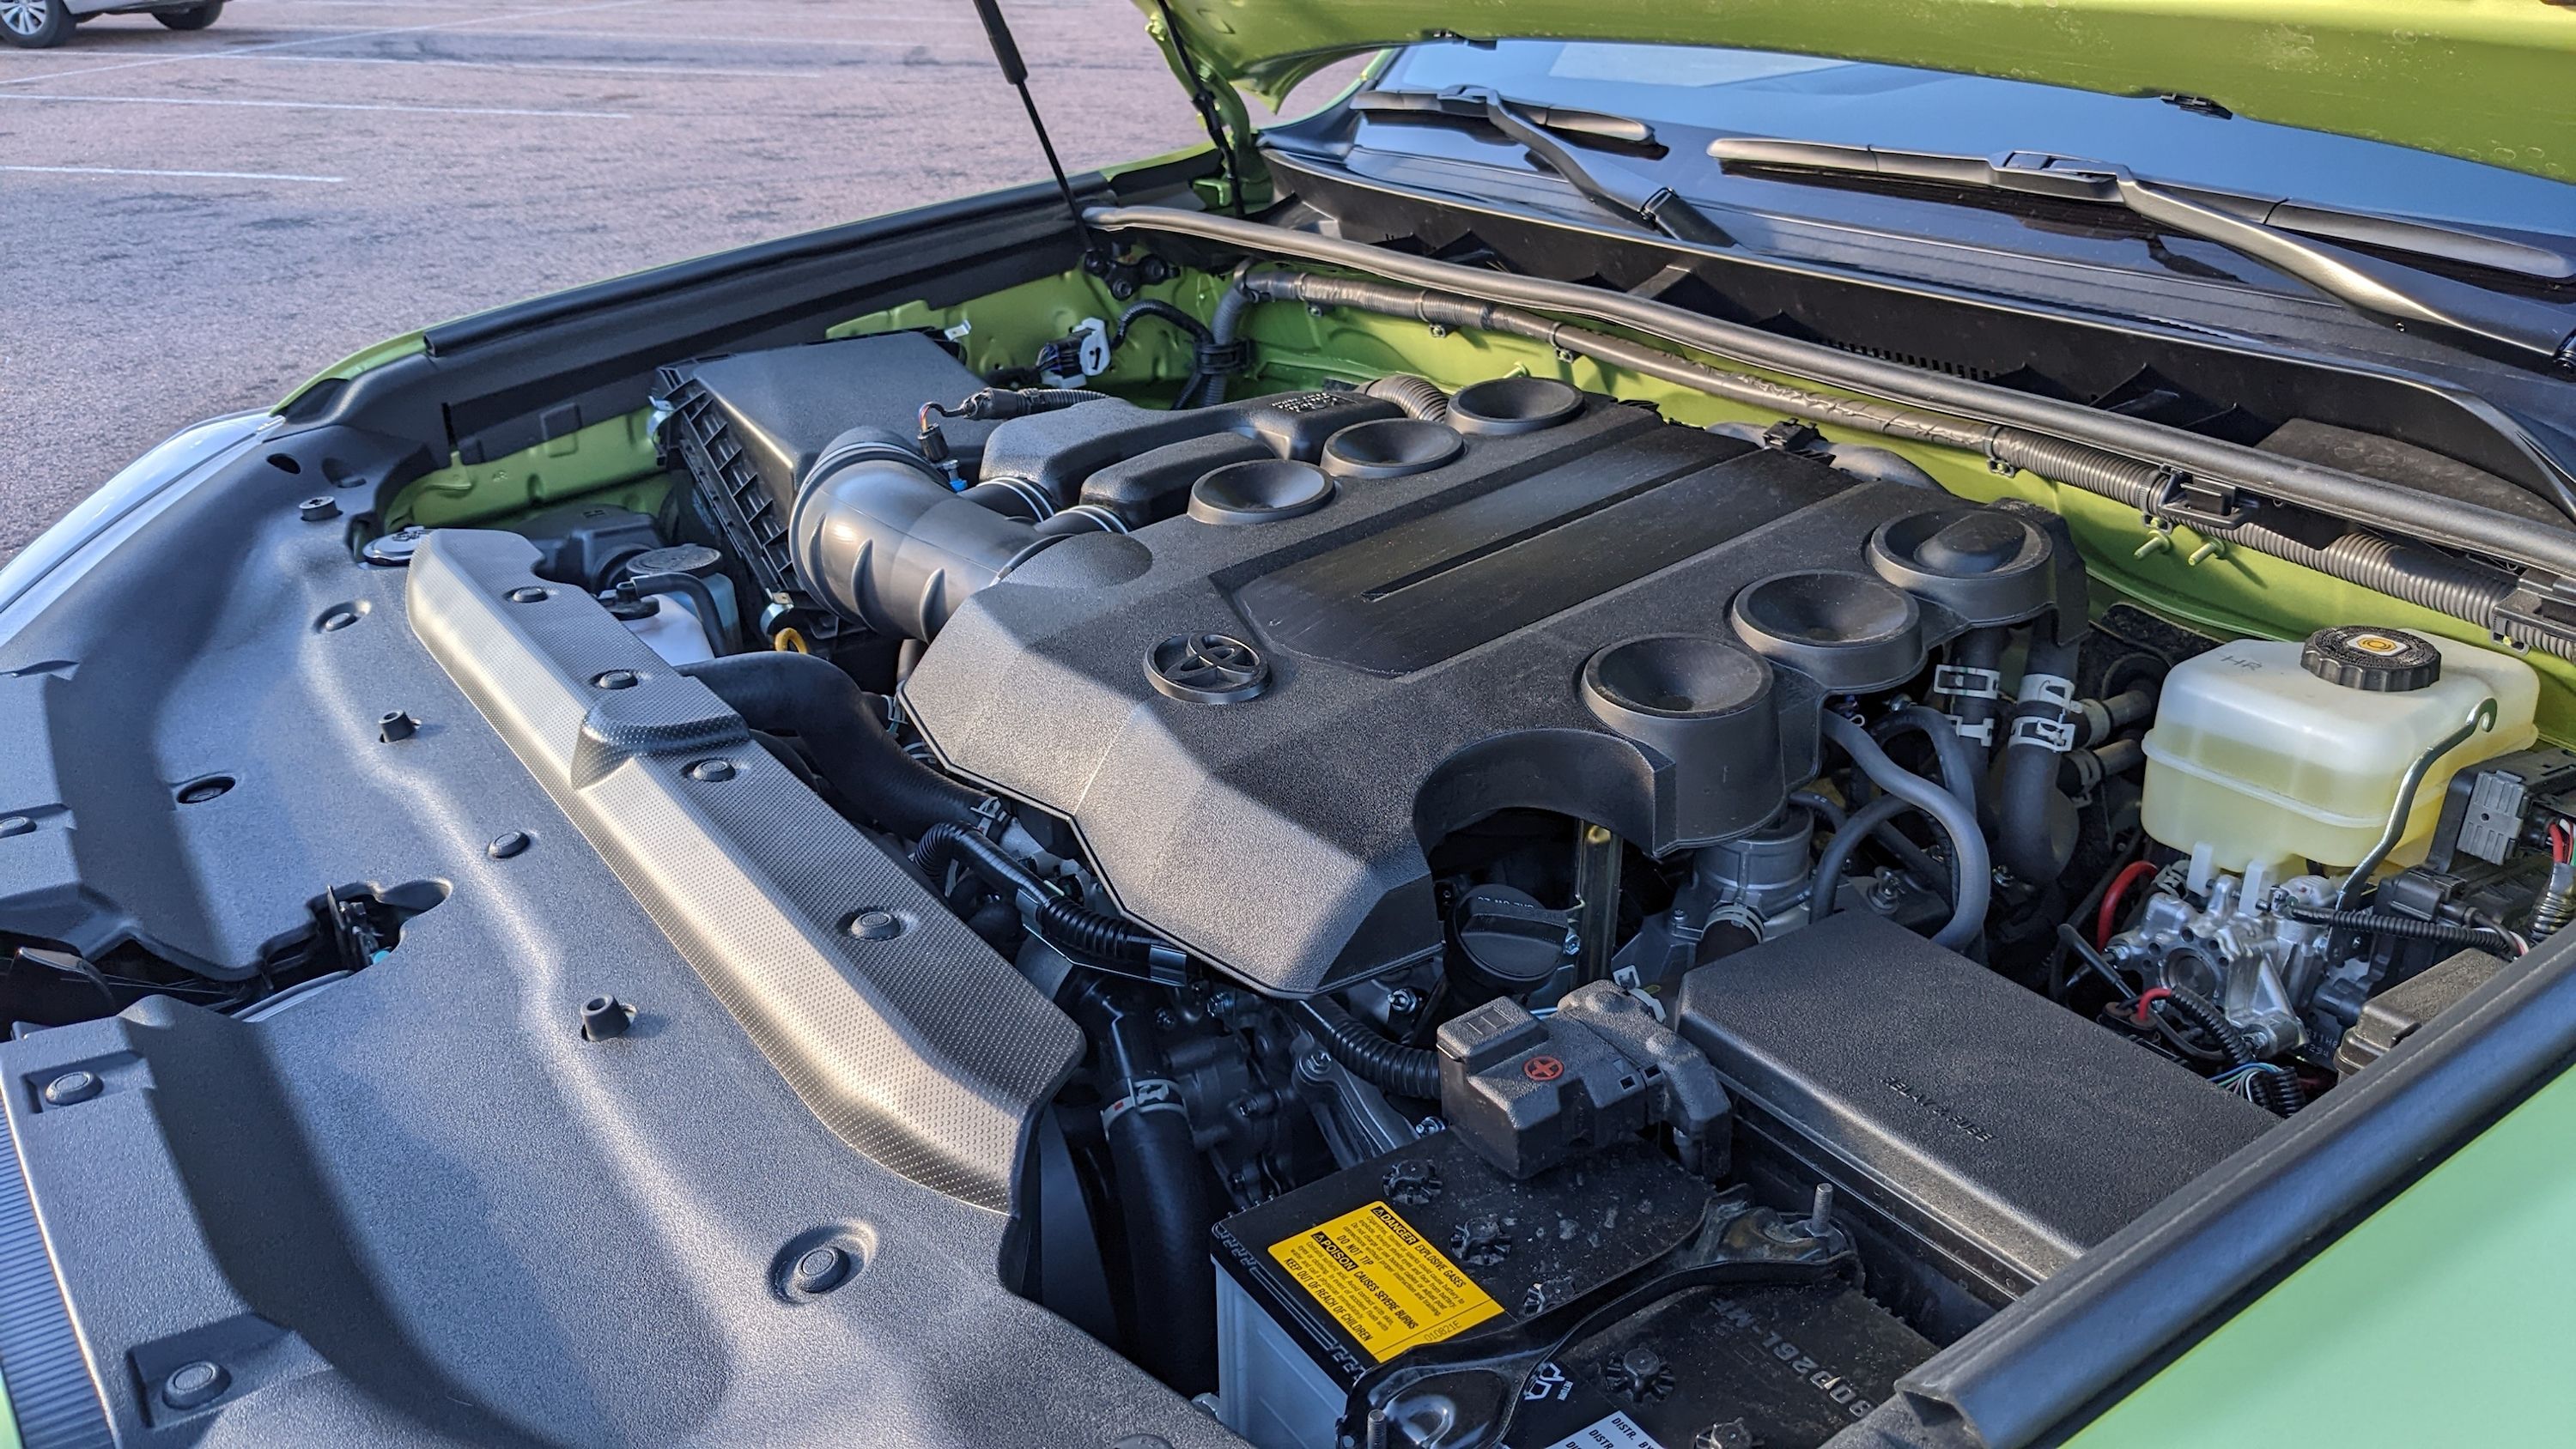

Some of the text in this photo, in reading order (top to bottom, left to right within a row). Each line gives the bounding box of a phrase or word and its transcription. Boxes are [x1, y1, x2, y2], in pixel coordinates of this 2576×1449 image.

[1291, 1249, 1303, 1259] water
[1318, 1277, 1340, 1295] physician
[1306, 1241, 1324, 1258] Contains
[1346, 1280, 1361, 1292] Avoid
[1358, 1291, 1376, 1306] contact
[1373, 1306, 1385, 1316] with
[1321, 1240, 1419, 1329] POISON CAUSES SEVERE BURNS
[1336, 1234, 1374, 1265] DO NOT TIP
[1343, 1227, 1441, 1317] connections without proper instruction and training.
[1363, 1234, 1378, 1247] charge
[1388, 1257, 1406, 1271] booster
[1404, 1271, 1419, 1284] cables
[1422, 1288, 1437, 1301] adjust
[1434, 1300, 1448, 1310] post
[1375, 1234, 1391, 1249] Always
[1389, 1247, 1404, 1259] shield
[1401, 1258, 1413, 1268] eyes
[1419, 1274, 1431, 1283] face
[1429, 1282, 1441, 1294] from
[1438, 1292, 1456, 1308] battery.
[1380, 1214, 1467, 1288] DANGER EXPLOSIVE GASES
[1405, 1252, 1421, 1264] sparks
[1419, 1264, 1433, 1275] could
[1430, 1274, 1444, 1285] cause
[1442, 1283, 1460, 1300] battery
[1284, 1258, 1373, 1342] KEEP OUT OF REACH OF CHILDREN
[1298, 1246, 1309, 1255] eyes
[1333, 1279, 1346, 1290] event
[1349, 1294, 1368, 1311] accident
[1366, 1310, 1378, 1321] flush
[1376, 1321, 1388, 1331] with
[1611, 1417, 1637, 1440] DISTR.
